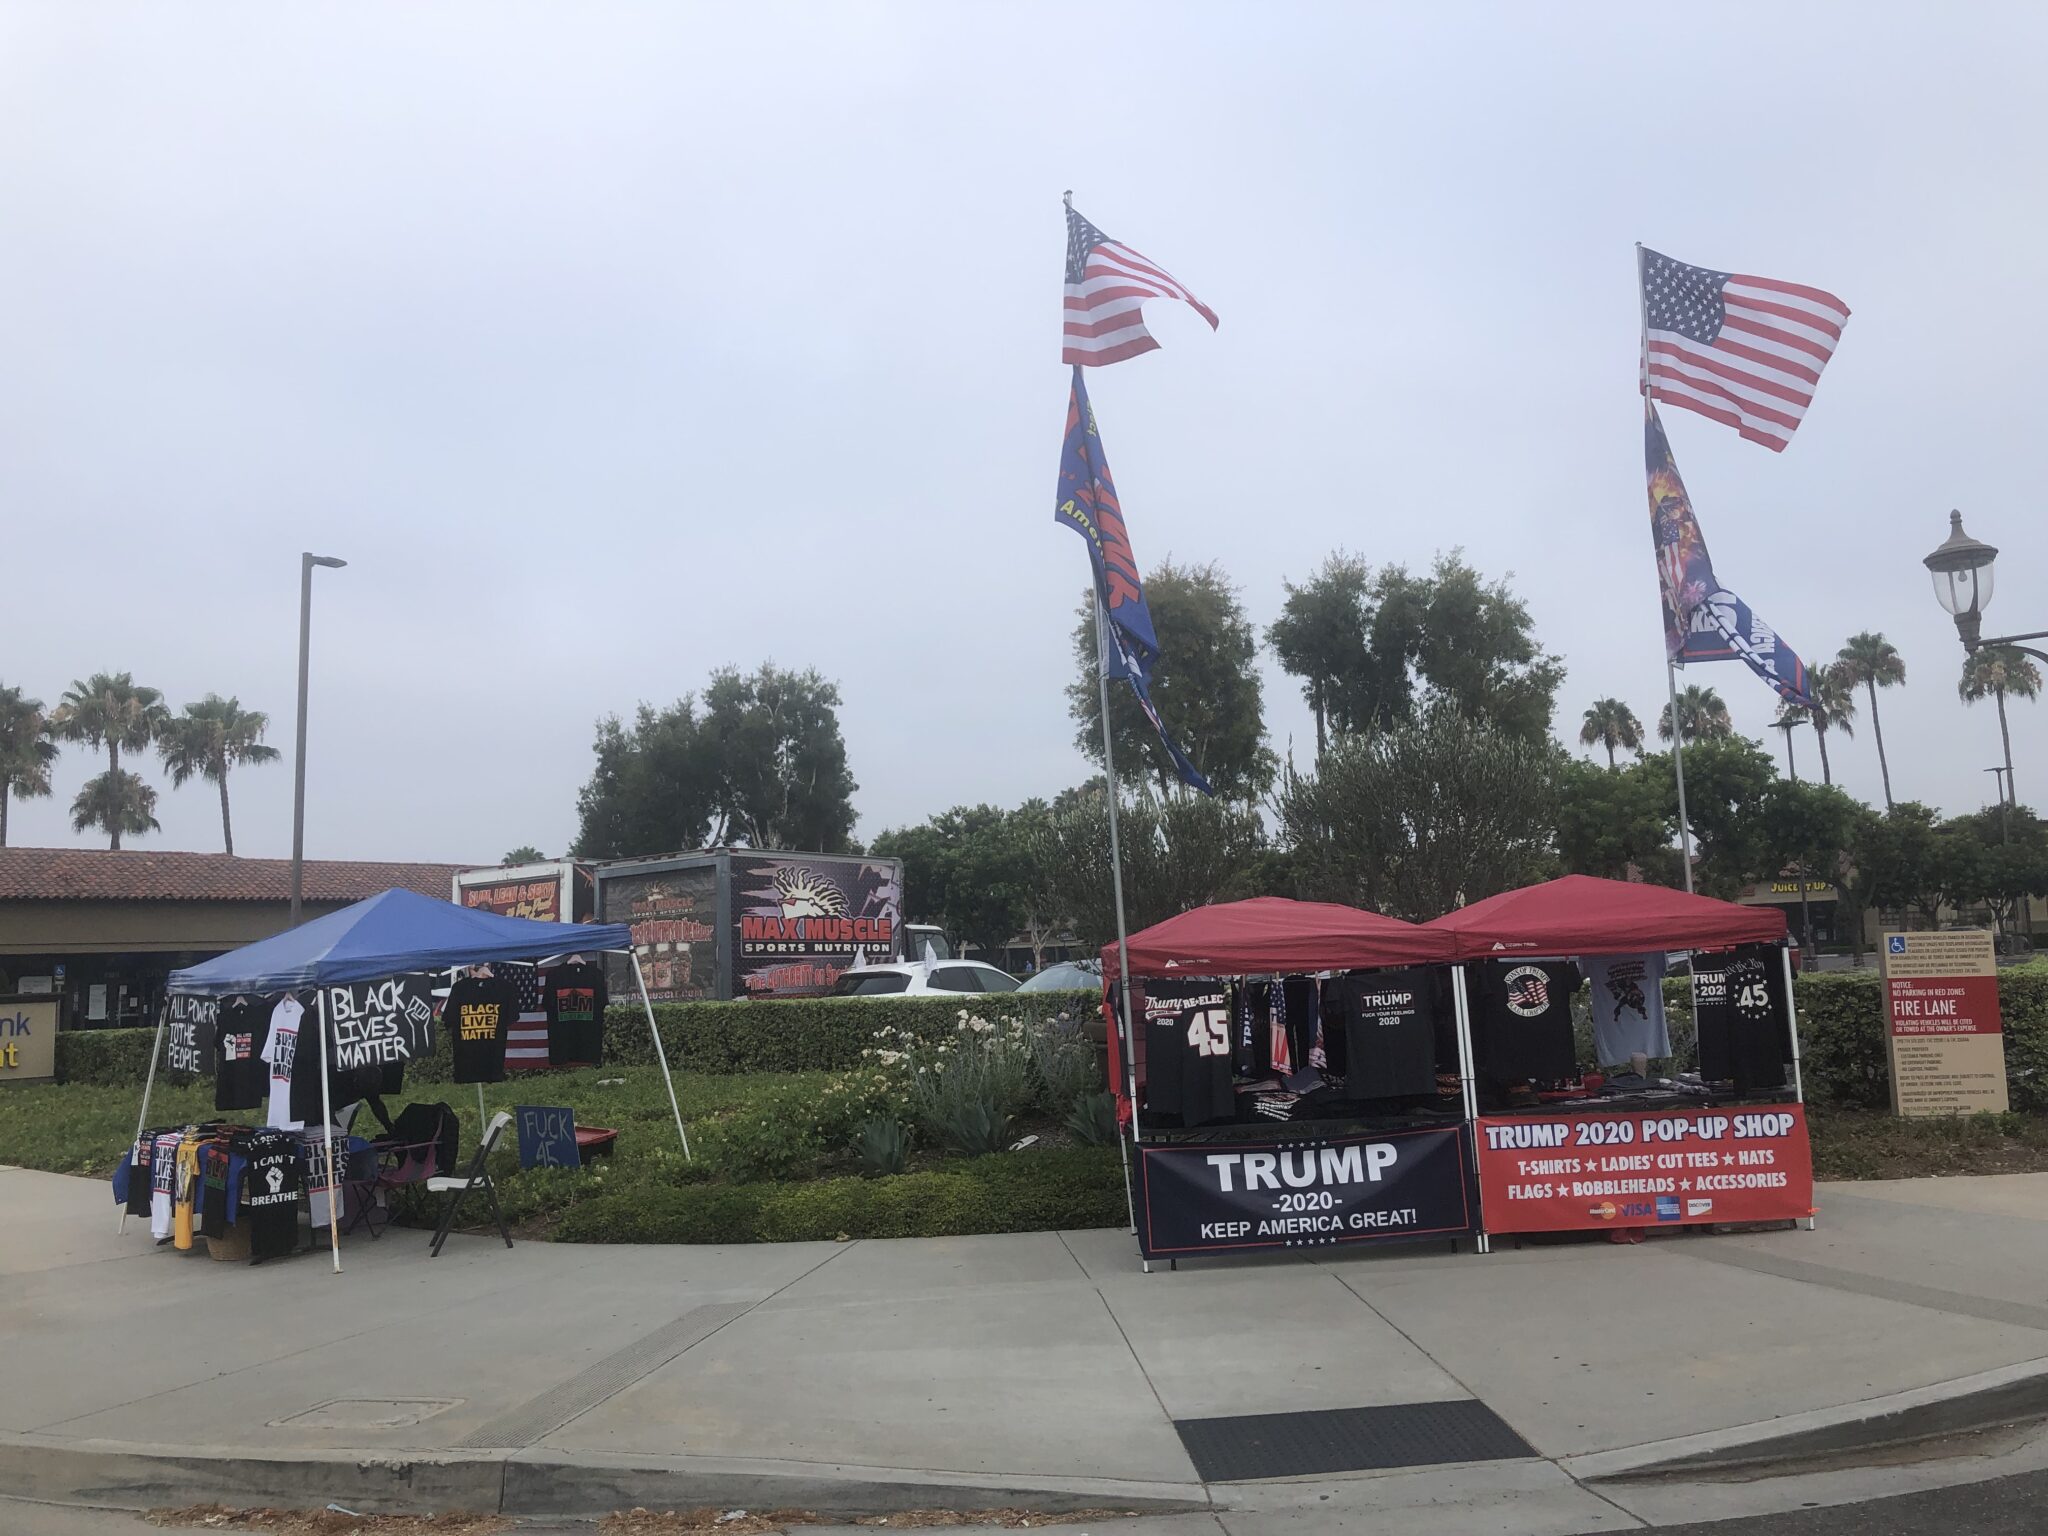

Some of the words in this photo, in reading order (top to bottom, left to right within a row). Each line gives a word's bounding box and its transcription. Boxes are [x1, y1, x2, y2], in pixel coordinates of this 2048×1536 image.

[1771, 883, 1798, 893] JUICE
[1814, 882, 1826, 890] UP
[742, 916, 799, 940] MAX
[805, 917, 892, 940] MUSCLE
[745, 943, 806, 952] SPORTS
[815, 943, 890, 952] NUTRITION
[1693, 973, 1726, 984] TRUM
[331, 979, 406, 1021] BLACK
[1363, 993, 1412, 1007] TRUMP
[1740, 983, 1769, 1008] 45
[1935, 988, 1946, 996] RED
[1947, 988, 1965, 996] ZONES
[169, 995, 187, 1020] ALL
[187, 998, 216, 1024] POWER
[559, 997, 592, 1012] BLM
[1894, 1000, 1921, 1016] FIRE
[1924, 1000, 1957, 1016] LANE
[334, 1013, 398, 1046] LIVES
[1157, 1018, 1175, 1026] 2020
[1188, 1010, 1230, 1056] 45
[1378, 1016, 1400, 1026] 2020
[461, 1029, 495, 1040] MATTE
[168, 1043, 201, 1073] PEOPLE
[337, 1037, 411, 1071] MATTER
[524, 1111, 572, 1141] FUCK
[1486, 1122, 1570, 1150] TRUMP
[1575, 1120, 1635, 1146] 2020
[1642, 1115, 1729, 1142] POP-UP
[1733, 1113, 1795, 1138] SHOP
[304, 1138, 349, 1159] BLCK
[536, 1140, 560, 1168] 45
[253, 1161, 258, 1170] I
[1206, 1142, 1398, 1193] TRUMP
[1518, 1158, 1581, 1176] T-SHIRTS
[1601, 1154, 1654, 1172] LADIES'
[1657, 1153, 1684, 1169] CUT
[1686, 1152, 1719, 1168] TEES
[1738, 1149, 1775, 1166] HATS
[1508, 1183, 1553, 1200] FLAGS
[1572, 1177, 1676, 1197] BOBBLEHEADS
[1696, 1171, 1787, 1191] ACCESSORIES
[251, 1191, 298, 1206] BREATHE
[1620, 1202, 1653, 1217] VISA
[1201, 1221, 1251, 1239] KEEP
[1257, 1215, 1344, 1236] AMERICA
[1349, 1208, 1417, 1229] GREAT!
